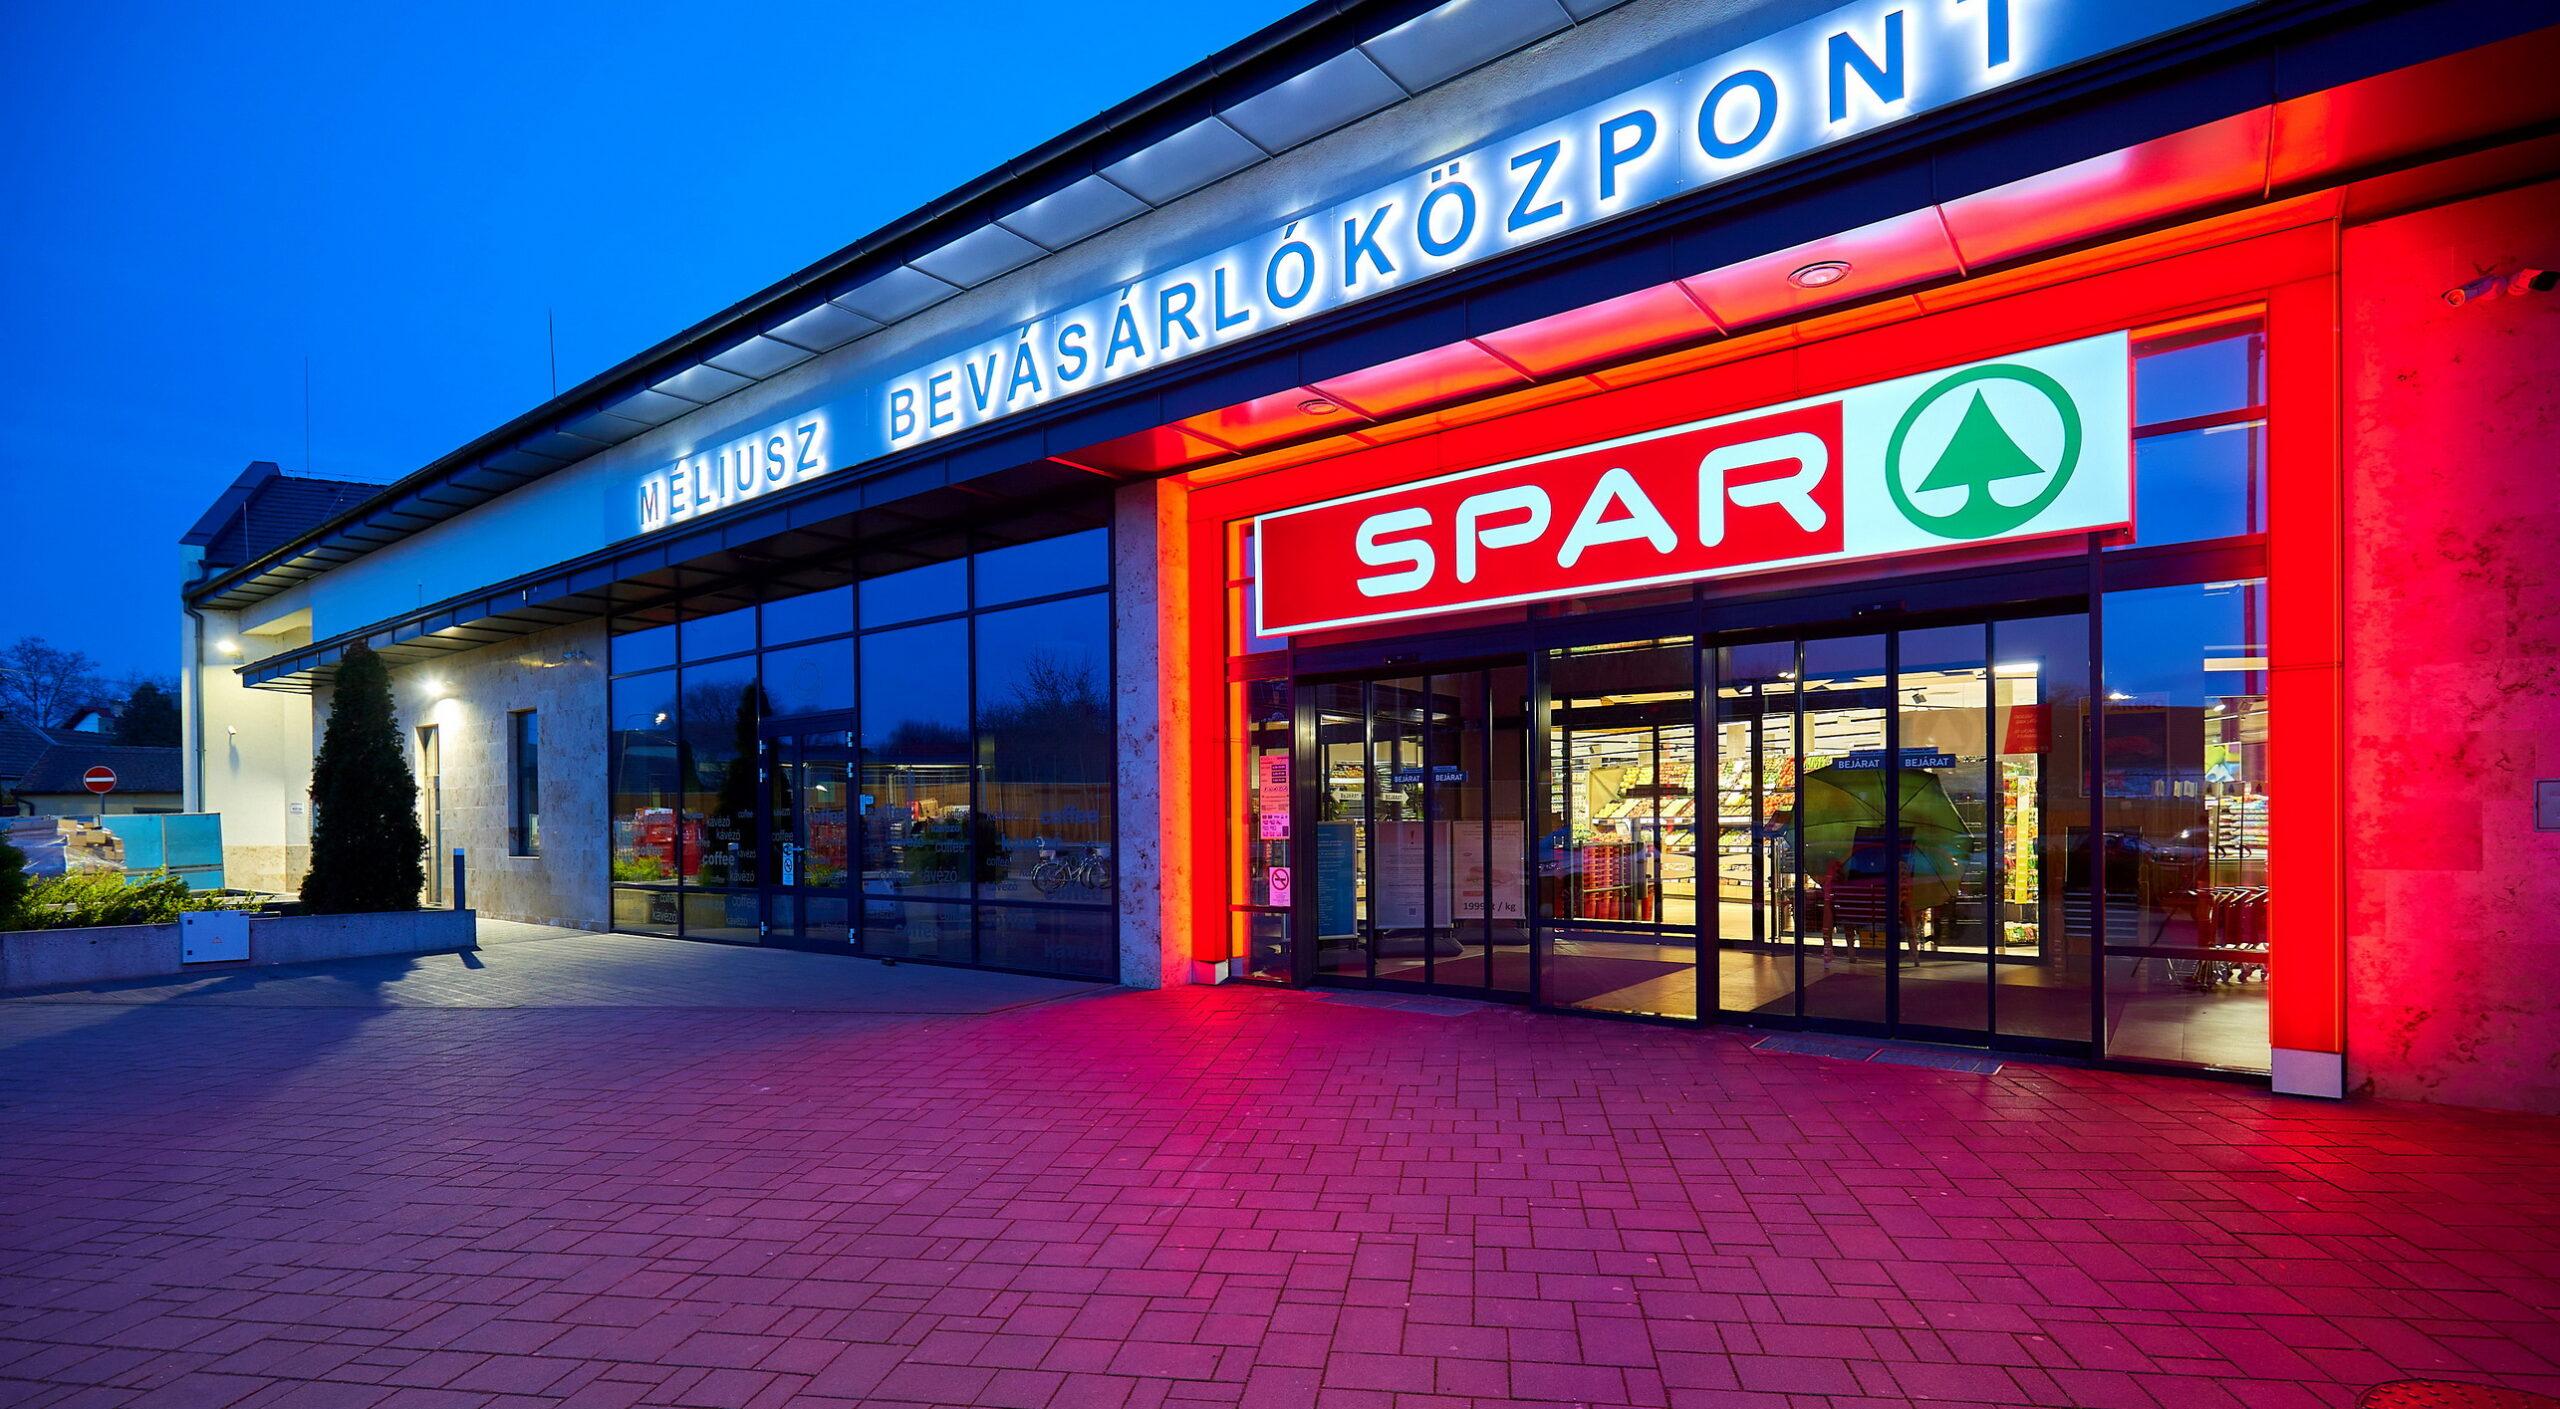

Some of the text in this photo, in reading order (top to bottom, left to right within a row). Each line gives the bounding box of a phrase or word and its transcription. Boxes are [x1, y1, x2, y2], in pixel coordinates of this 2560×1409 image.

[639, 0, 2010, 526] MÉLIUSZ BEVÁSÁRLÓKÖZPONT
[1355, 431, 1829, 597] SPAR
[1838, 758, 1880, 769] BEJÁRAT
[1905, 756, 1949, 767] BEJÁRAT
[1394, 774, 1420, 783] BEJÁRAT
[1435, 773, 1463, 782] BEJÁRAT
[702, 850, 736, 867] coffee
[729, 869, 755, 883] kávézó
[1505, 902, 1516, 912] kg
